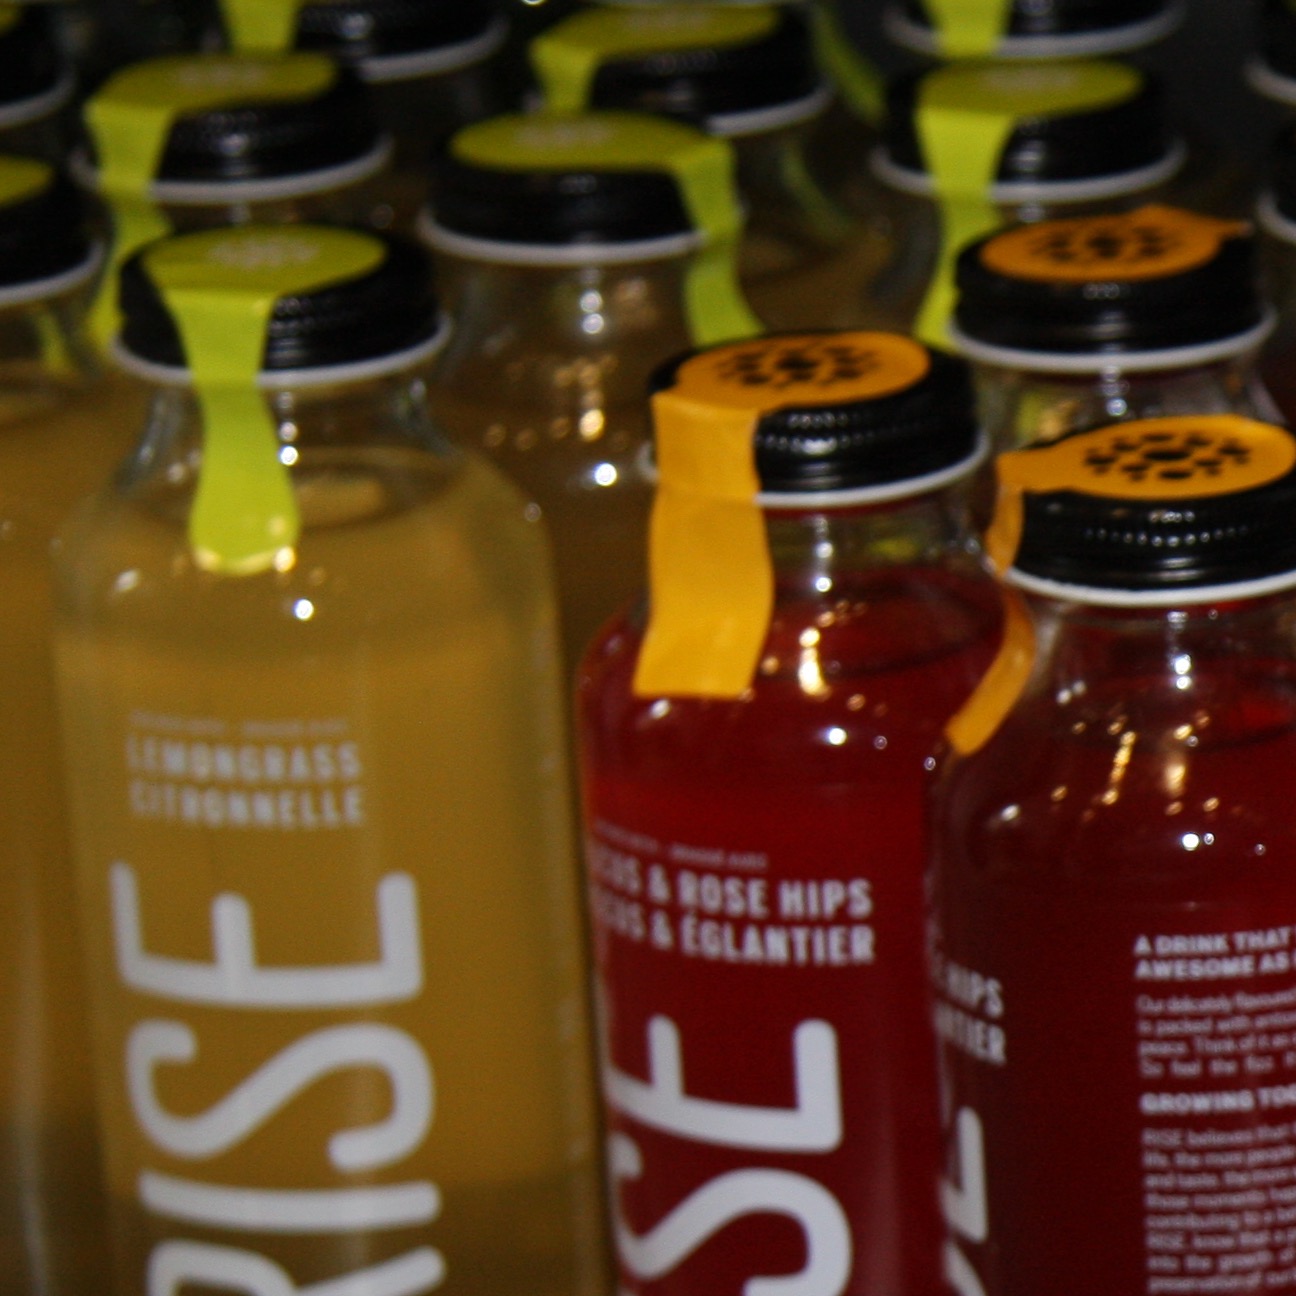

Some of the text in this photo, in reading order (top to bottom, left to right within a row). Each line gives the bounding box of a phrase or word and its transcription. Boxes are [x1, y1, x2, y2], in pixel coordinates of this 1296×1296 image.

[127, 738, 362, 783] LEMONGRASS
[129, 781, 364, 829] CITRONNELLE
[678, 870, 767, 917] ROSE
[778, 877, 873, 919] HIPS
[681, 910, 875, 966] ÉGLANTIER
